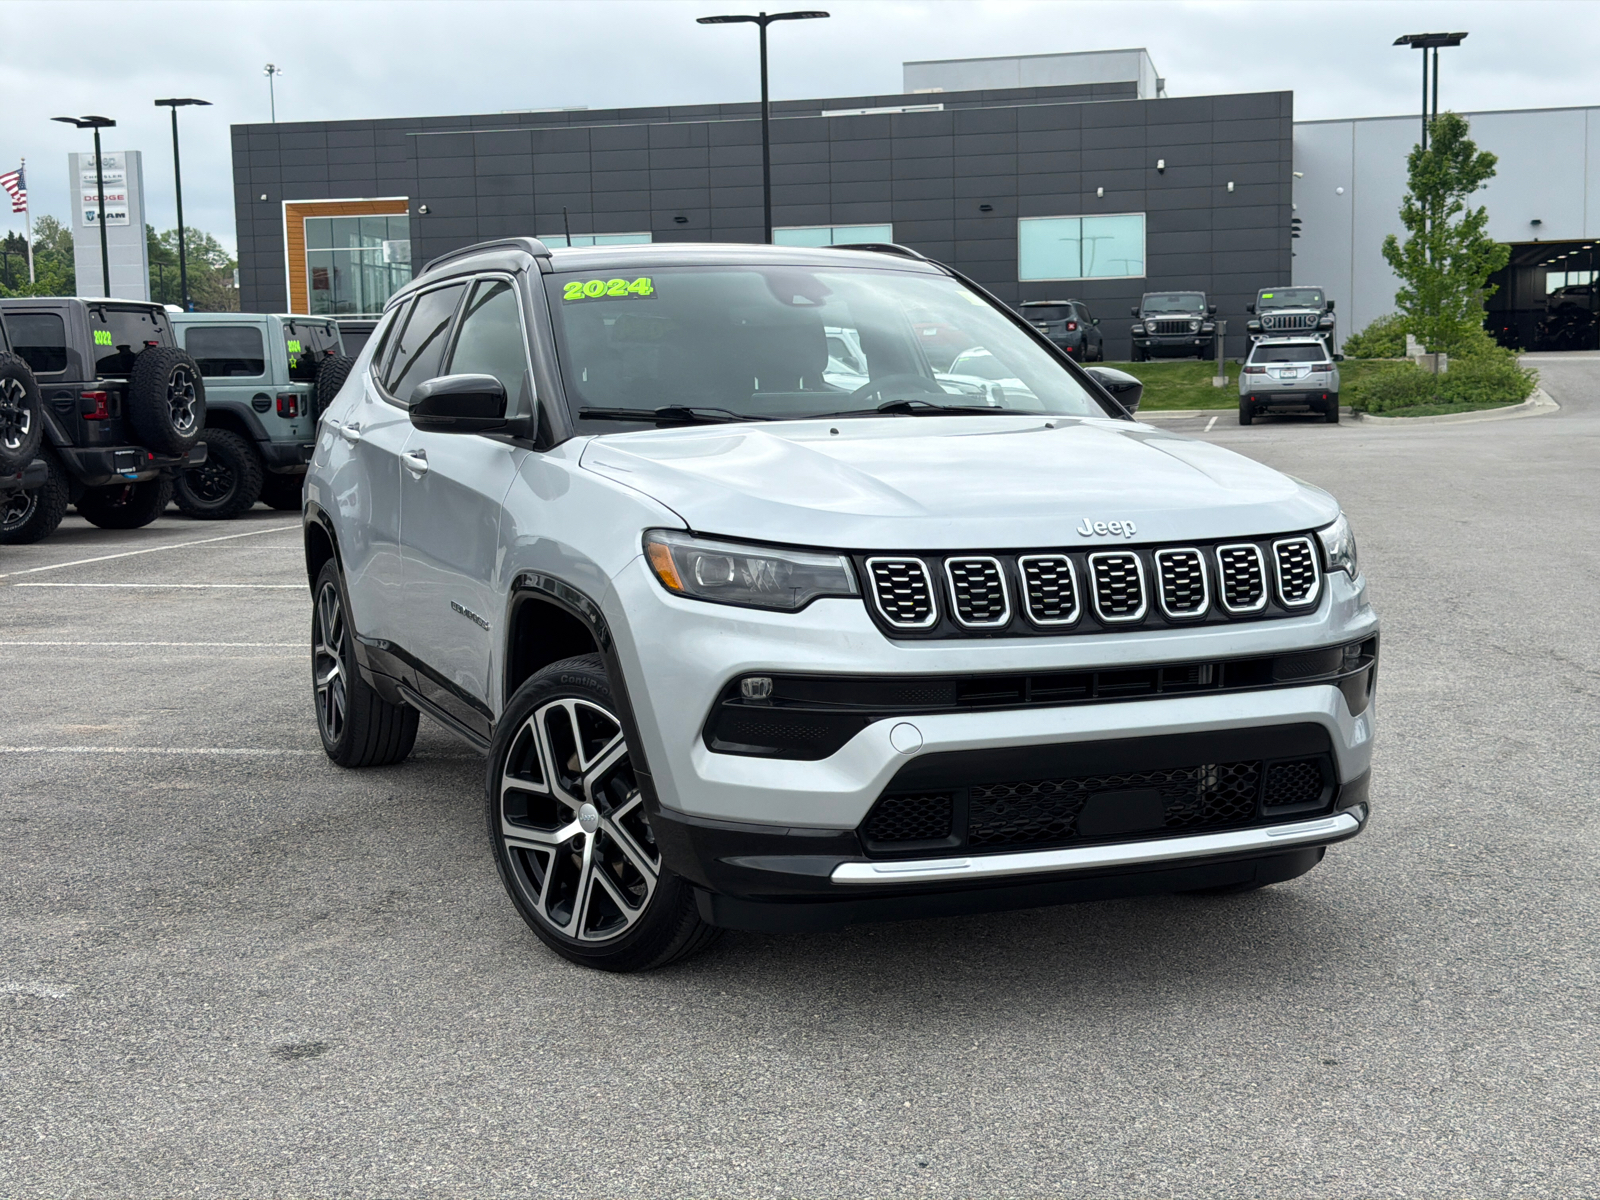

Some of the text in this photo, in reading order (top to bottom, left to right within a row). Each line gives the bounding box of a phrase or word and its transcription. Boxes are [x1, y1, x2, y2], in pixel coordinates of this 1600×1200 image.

[87, 155, 116, 168] Jep
[563, 277, 654, 301] 2024
[1076, 517, 1137, 539] Jeep
